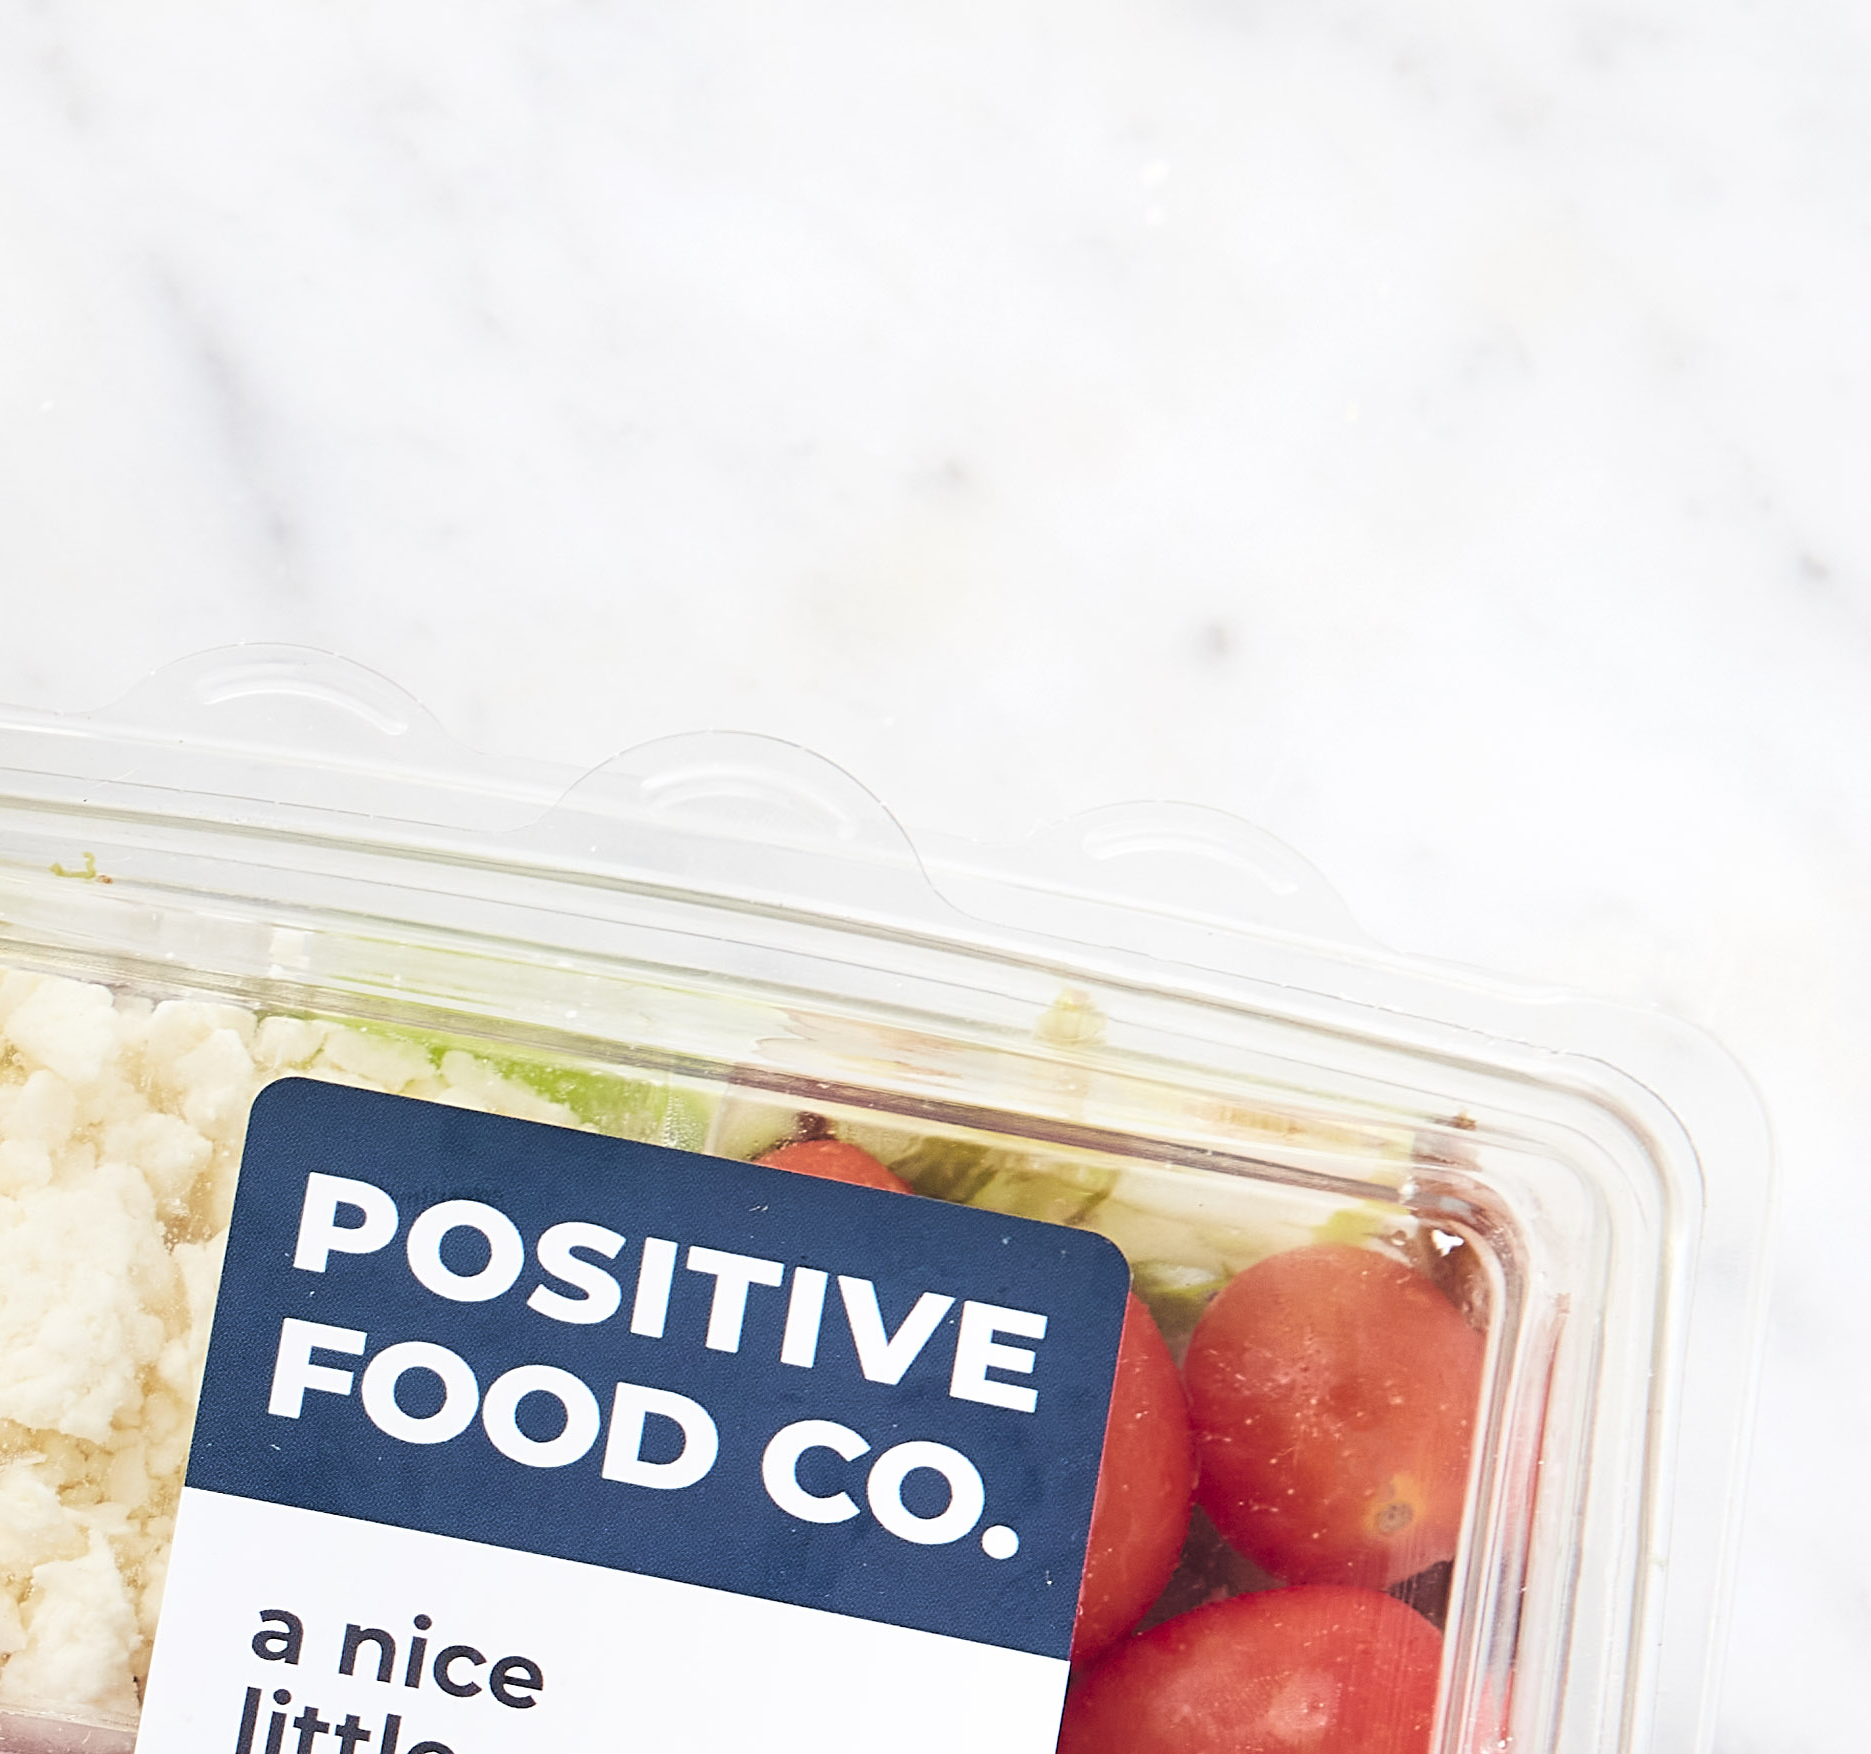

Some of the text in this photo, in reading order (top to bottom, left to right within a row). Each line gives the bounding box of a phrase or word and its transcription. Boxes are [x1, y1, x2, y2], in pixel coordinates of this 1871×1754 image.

[293, 1172, 1047, 1413] POSITIVE
[268, 1318, 1019, 1559] FOOD CO.
[252, 1609, 543, 1709] a nice
